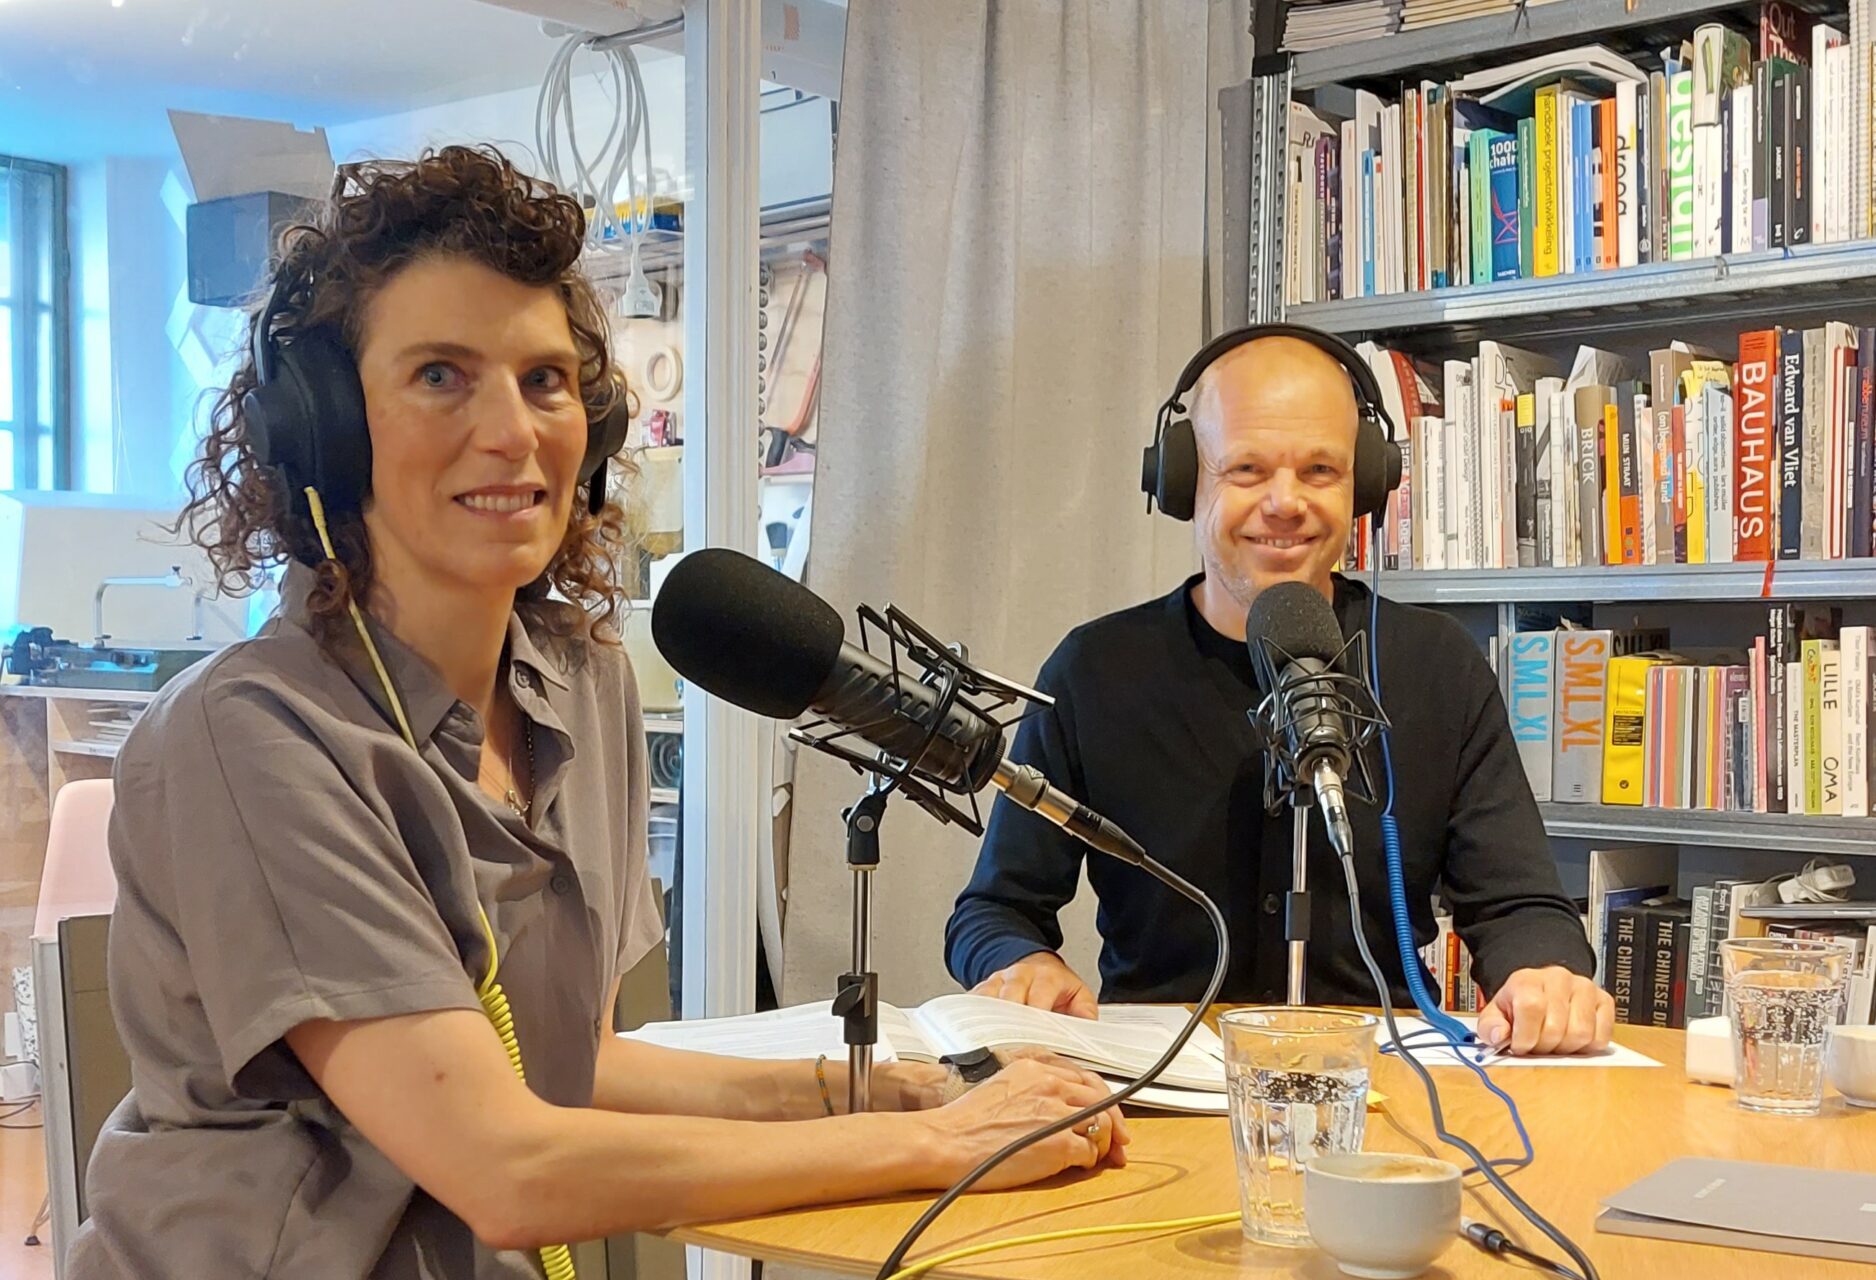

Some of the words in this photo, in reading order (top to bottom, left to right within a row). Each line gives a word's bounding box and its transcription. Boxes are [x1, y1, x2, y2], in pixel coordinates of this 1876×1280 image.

[1544, 93, 1555, 145] handboek
[1489, 152, 1517, 169] chair
[1784, 354, 1799, 413] Edward
[1739, 361, 1766, 539] BAUHAUS
[1785, 417, 1795, 446] van
[1581, 428, 1595, 484] BRICK
[1784, 448, 1799, 488] Vliet
[1823, 663, 1838, 710] LILLE
[1823, 757, 1838, 802] OMA
[1618, 917, 1634, 943] THE
[1657, 920, 1673, 947] THE
[1615, 945, 1633, 1005] CHINESE
[1654, 949, 1671, 1009] CHINESE
